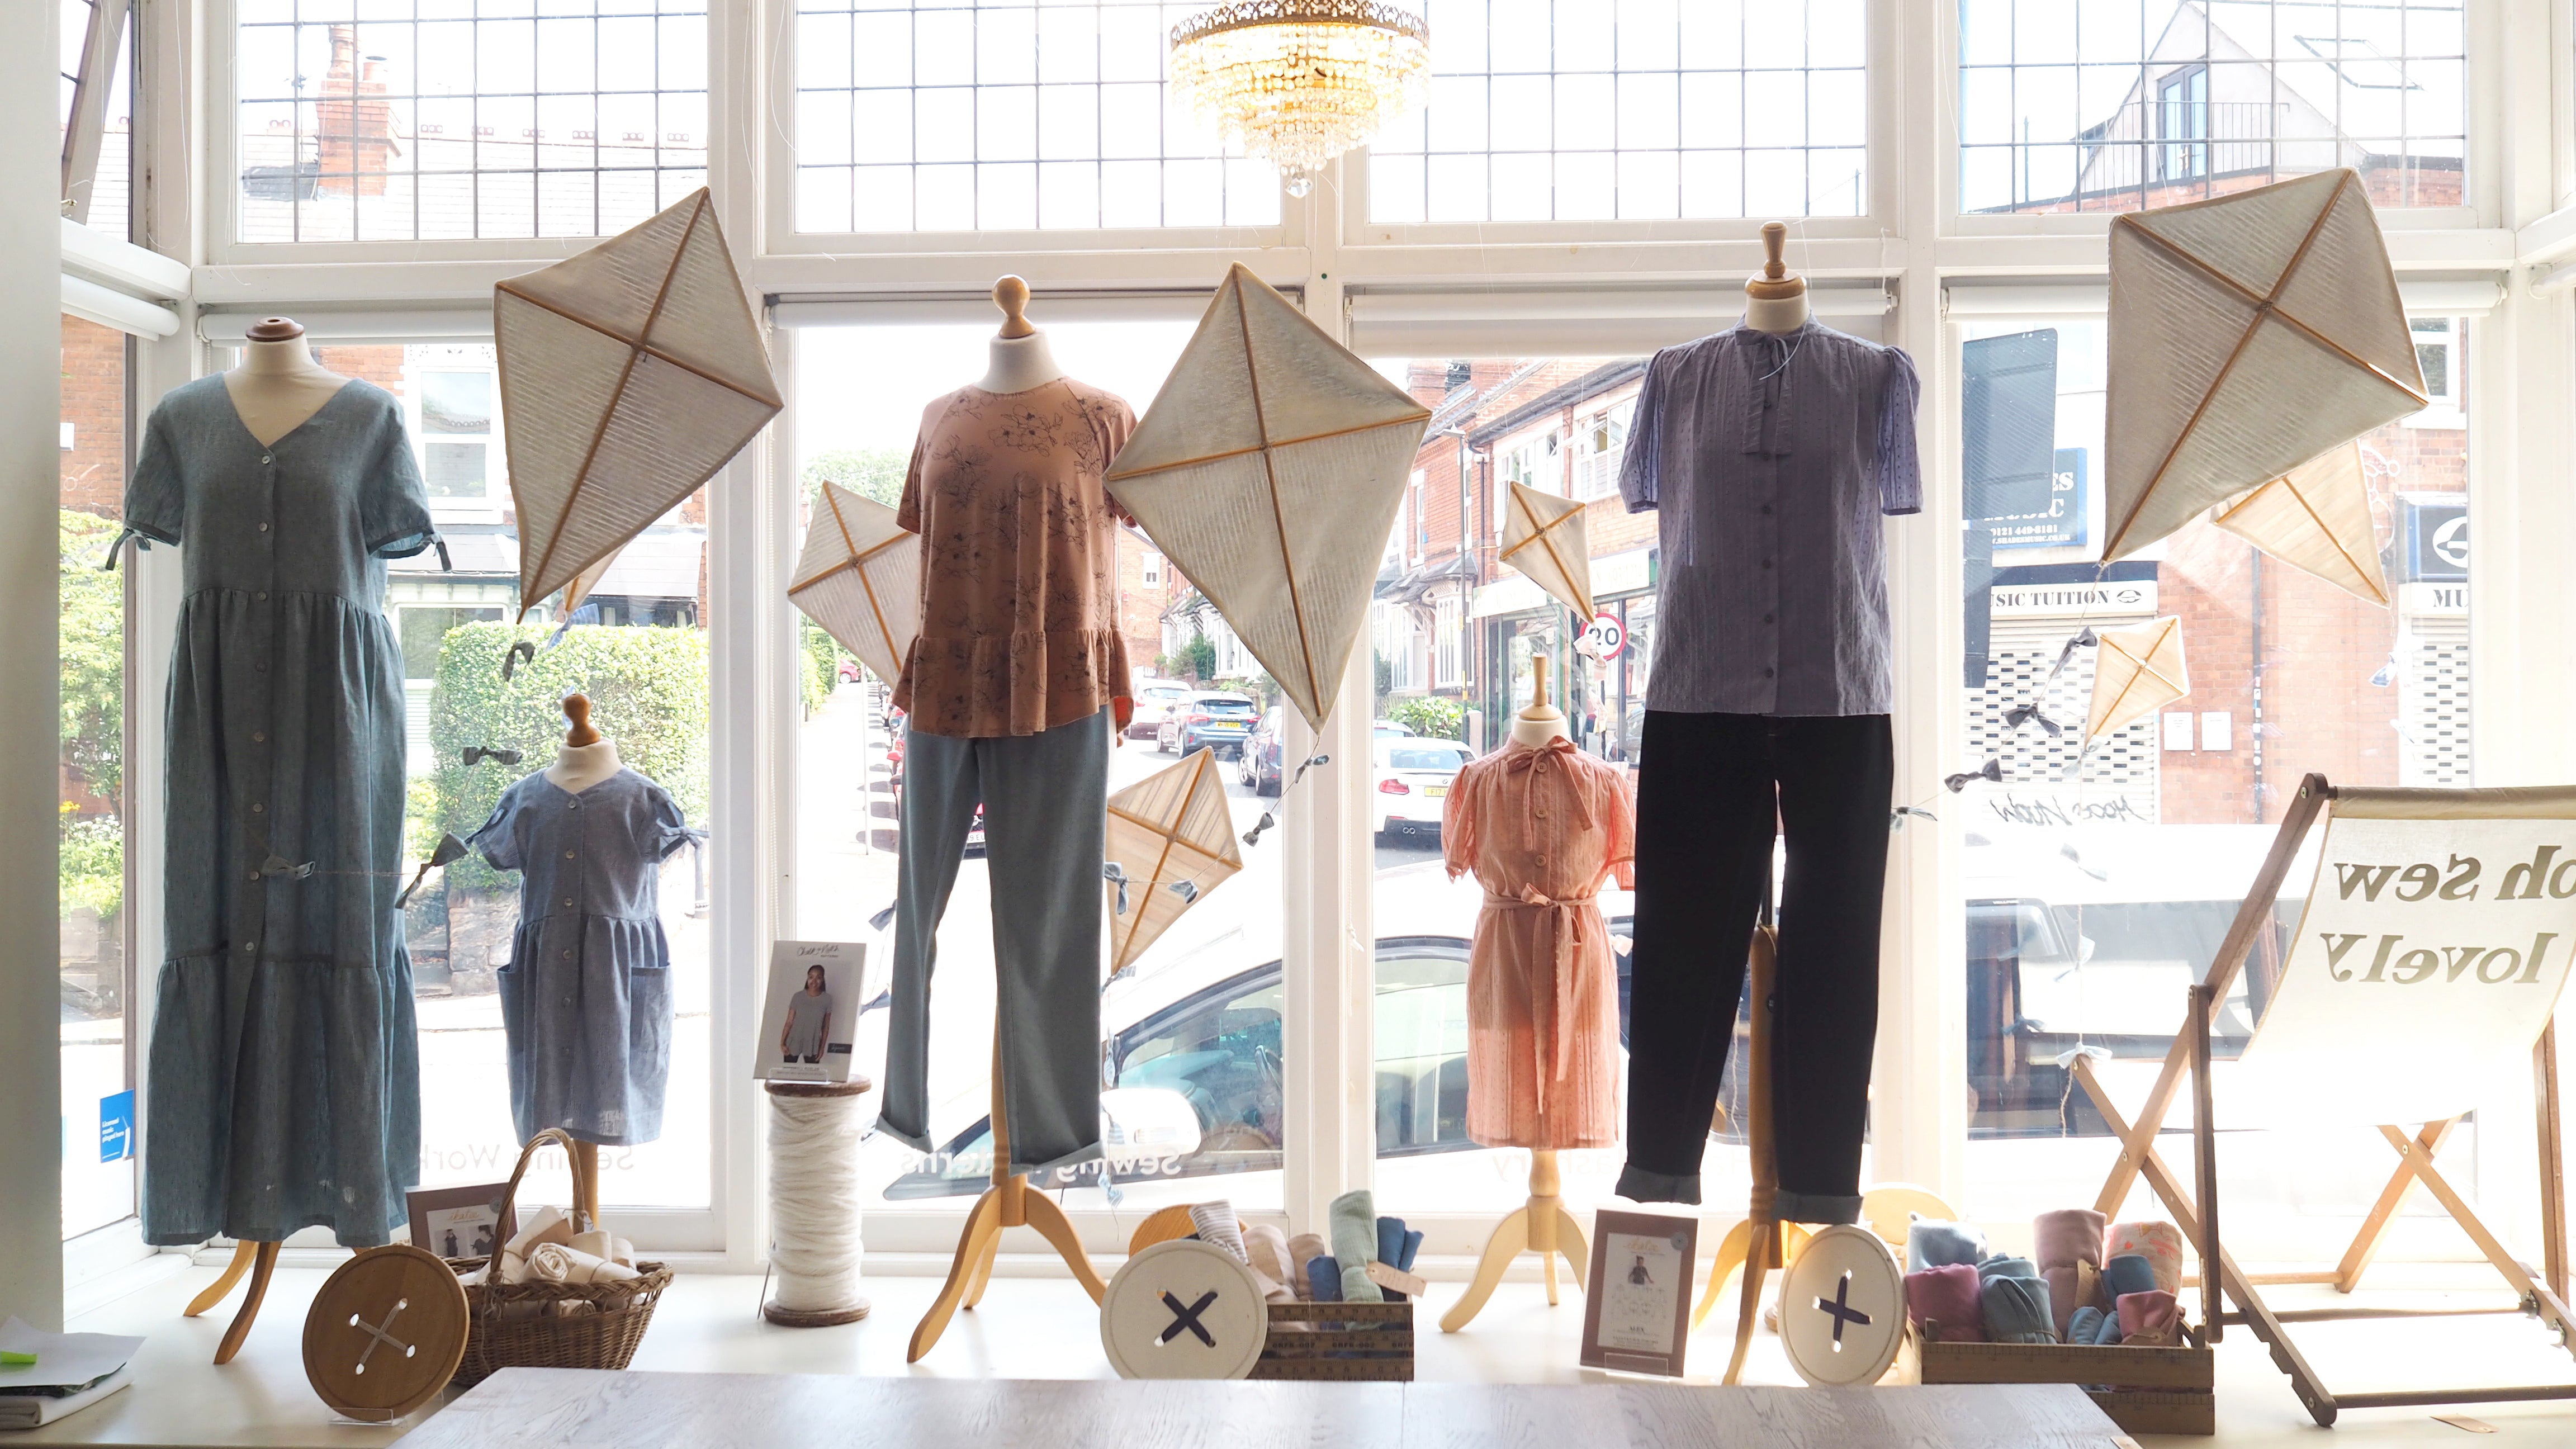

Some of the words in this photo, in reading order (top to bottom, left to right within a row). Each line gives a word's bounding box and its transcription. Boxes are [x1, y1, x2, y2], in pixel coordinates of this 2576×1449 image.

[1990, 591, 2025, 607] SIC
[2030, 590, 2109, 605] TUITION
[1588, 627, 1620, 646] 20
